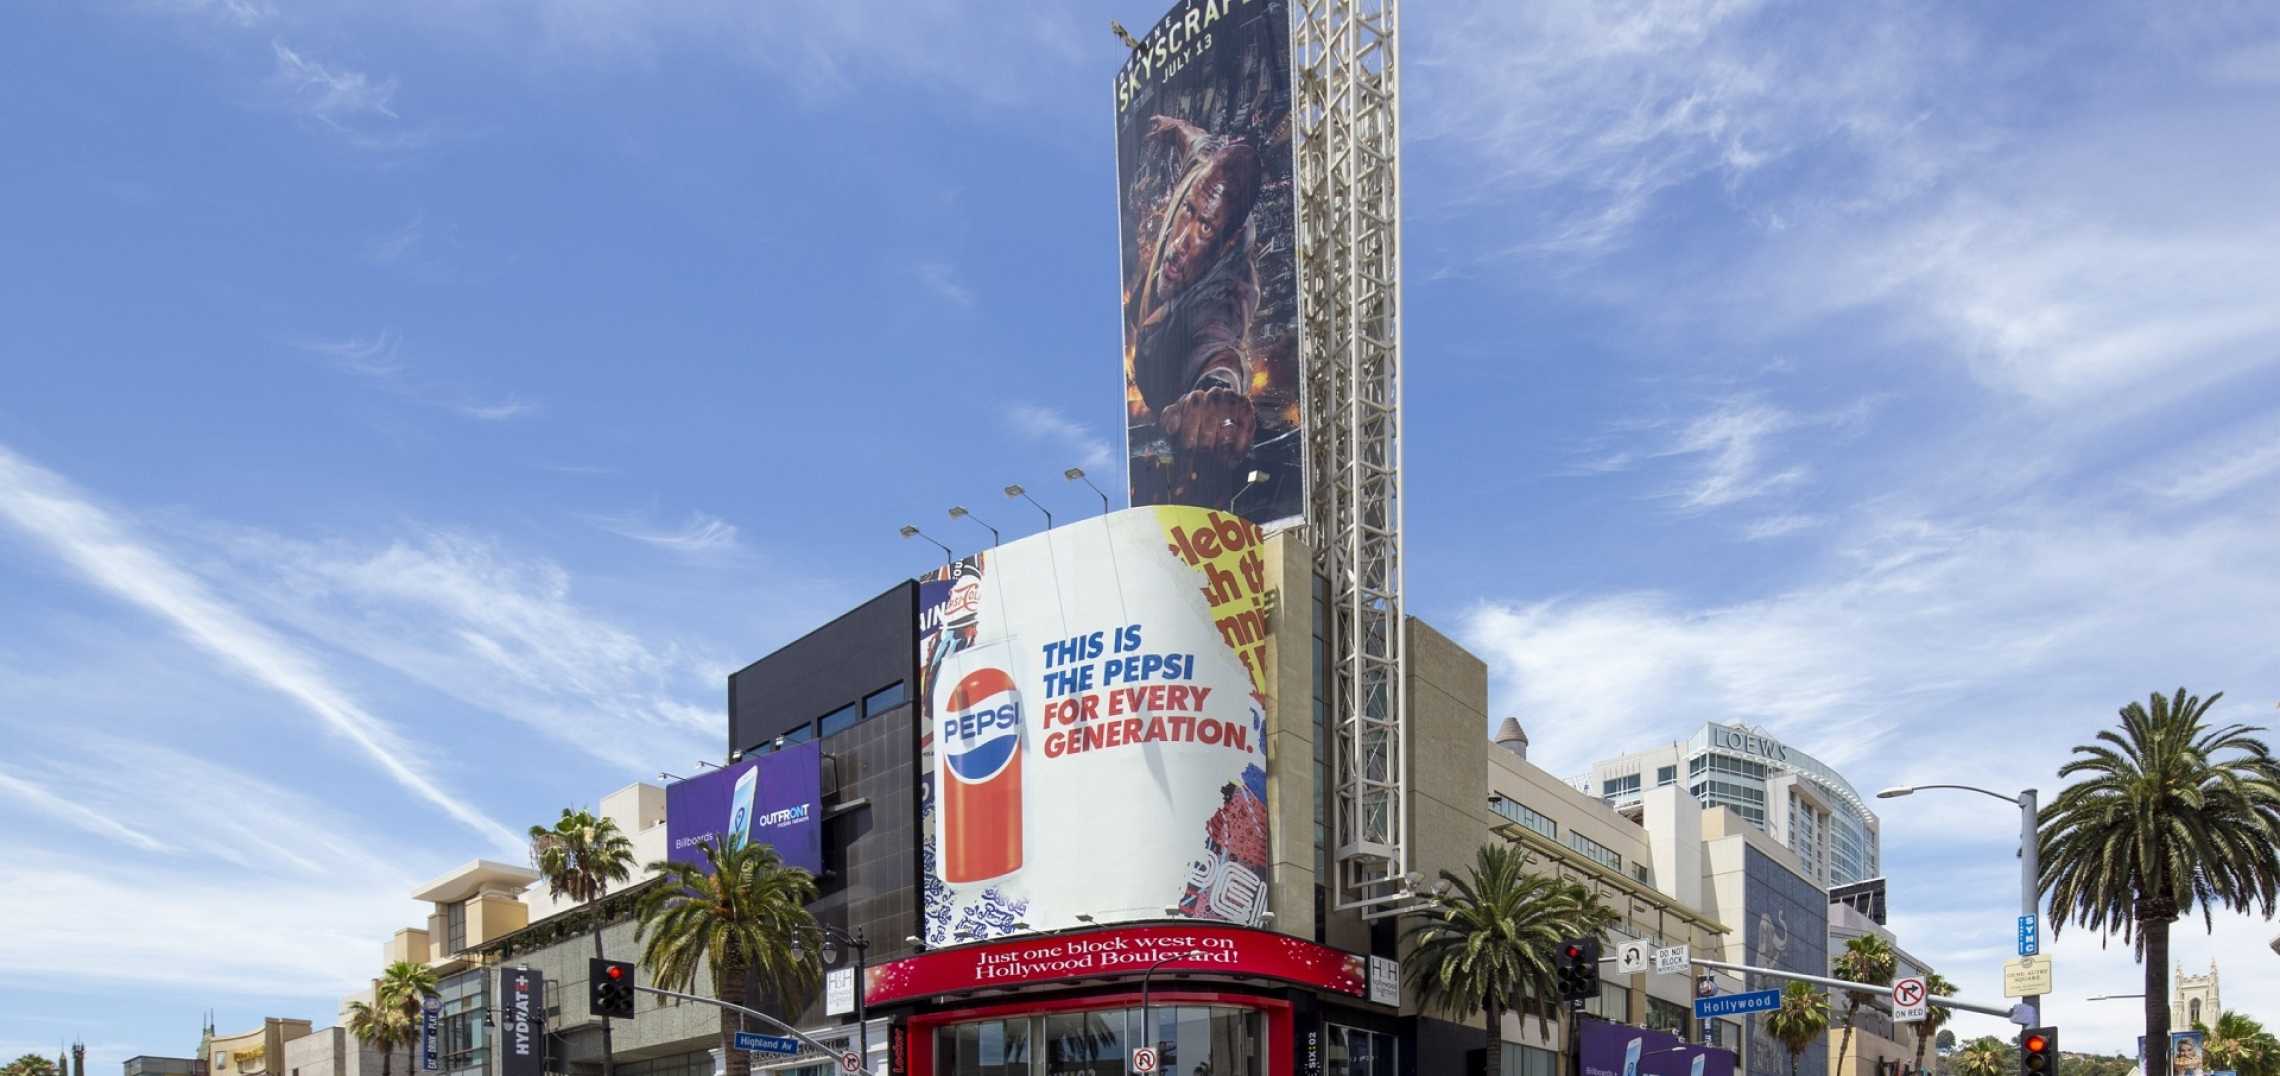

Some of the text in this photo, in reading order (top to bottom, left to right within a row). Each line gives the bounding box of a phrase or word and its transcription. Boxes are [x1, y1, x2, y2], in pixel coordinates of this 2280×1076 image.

[1162, 33, 1212, 84] JULY 13
[1042, 624, 1142, 669] THIS IS
[1043, 653, 1194, 699] THE PEPSI
[944, 701, 1019, 744] PEPSI
[1043, 684, 1212, 729] FOR EVERY
[1044, 716, 1254, 759] GENERATION.
[1715, 727, 1787, 762] LOEWS
[759, 804, 810, 827] OUTFRONT
[977, 936, 1234, 966] Just one block west on
[2025, 916, 2034, 952] SYNC
[975, 949, 1239, 980] Hollywood Boulevard!
[1660, 947, 1684, 959] DO NOT
[1704, 995, 1772, 1013] Hollywood
[1907, 1008, 1923, 1017] RED
[740, 1036, 793, 1051] Highland Av
[1308, 1032, 1318, 1069] SIX:02
